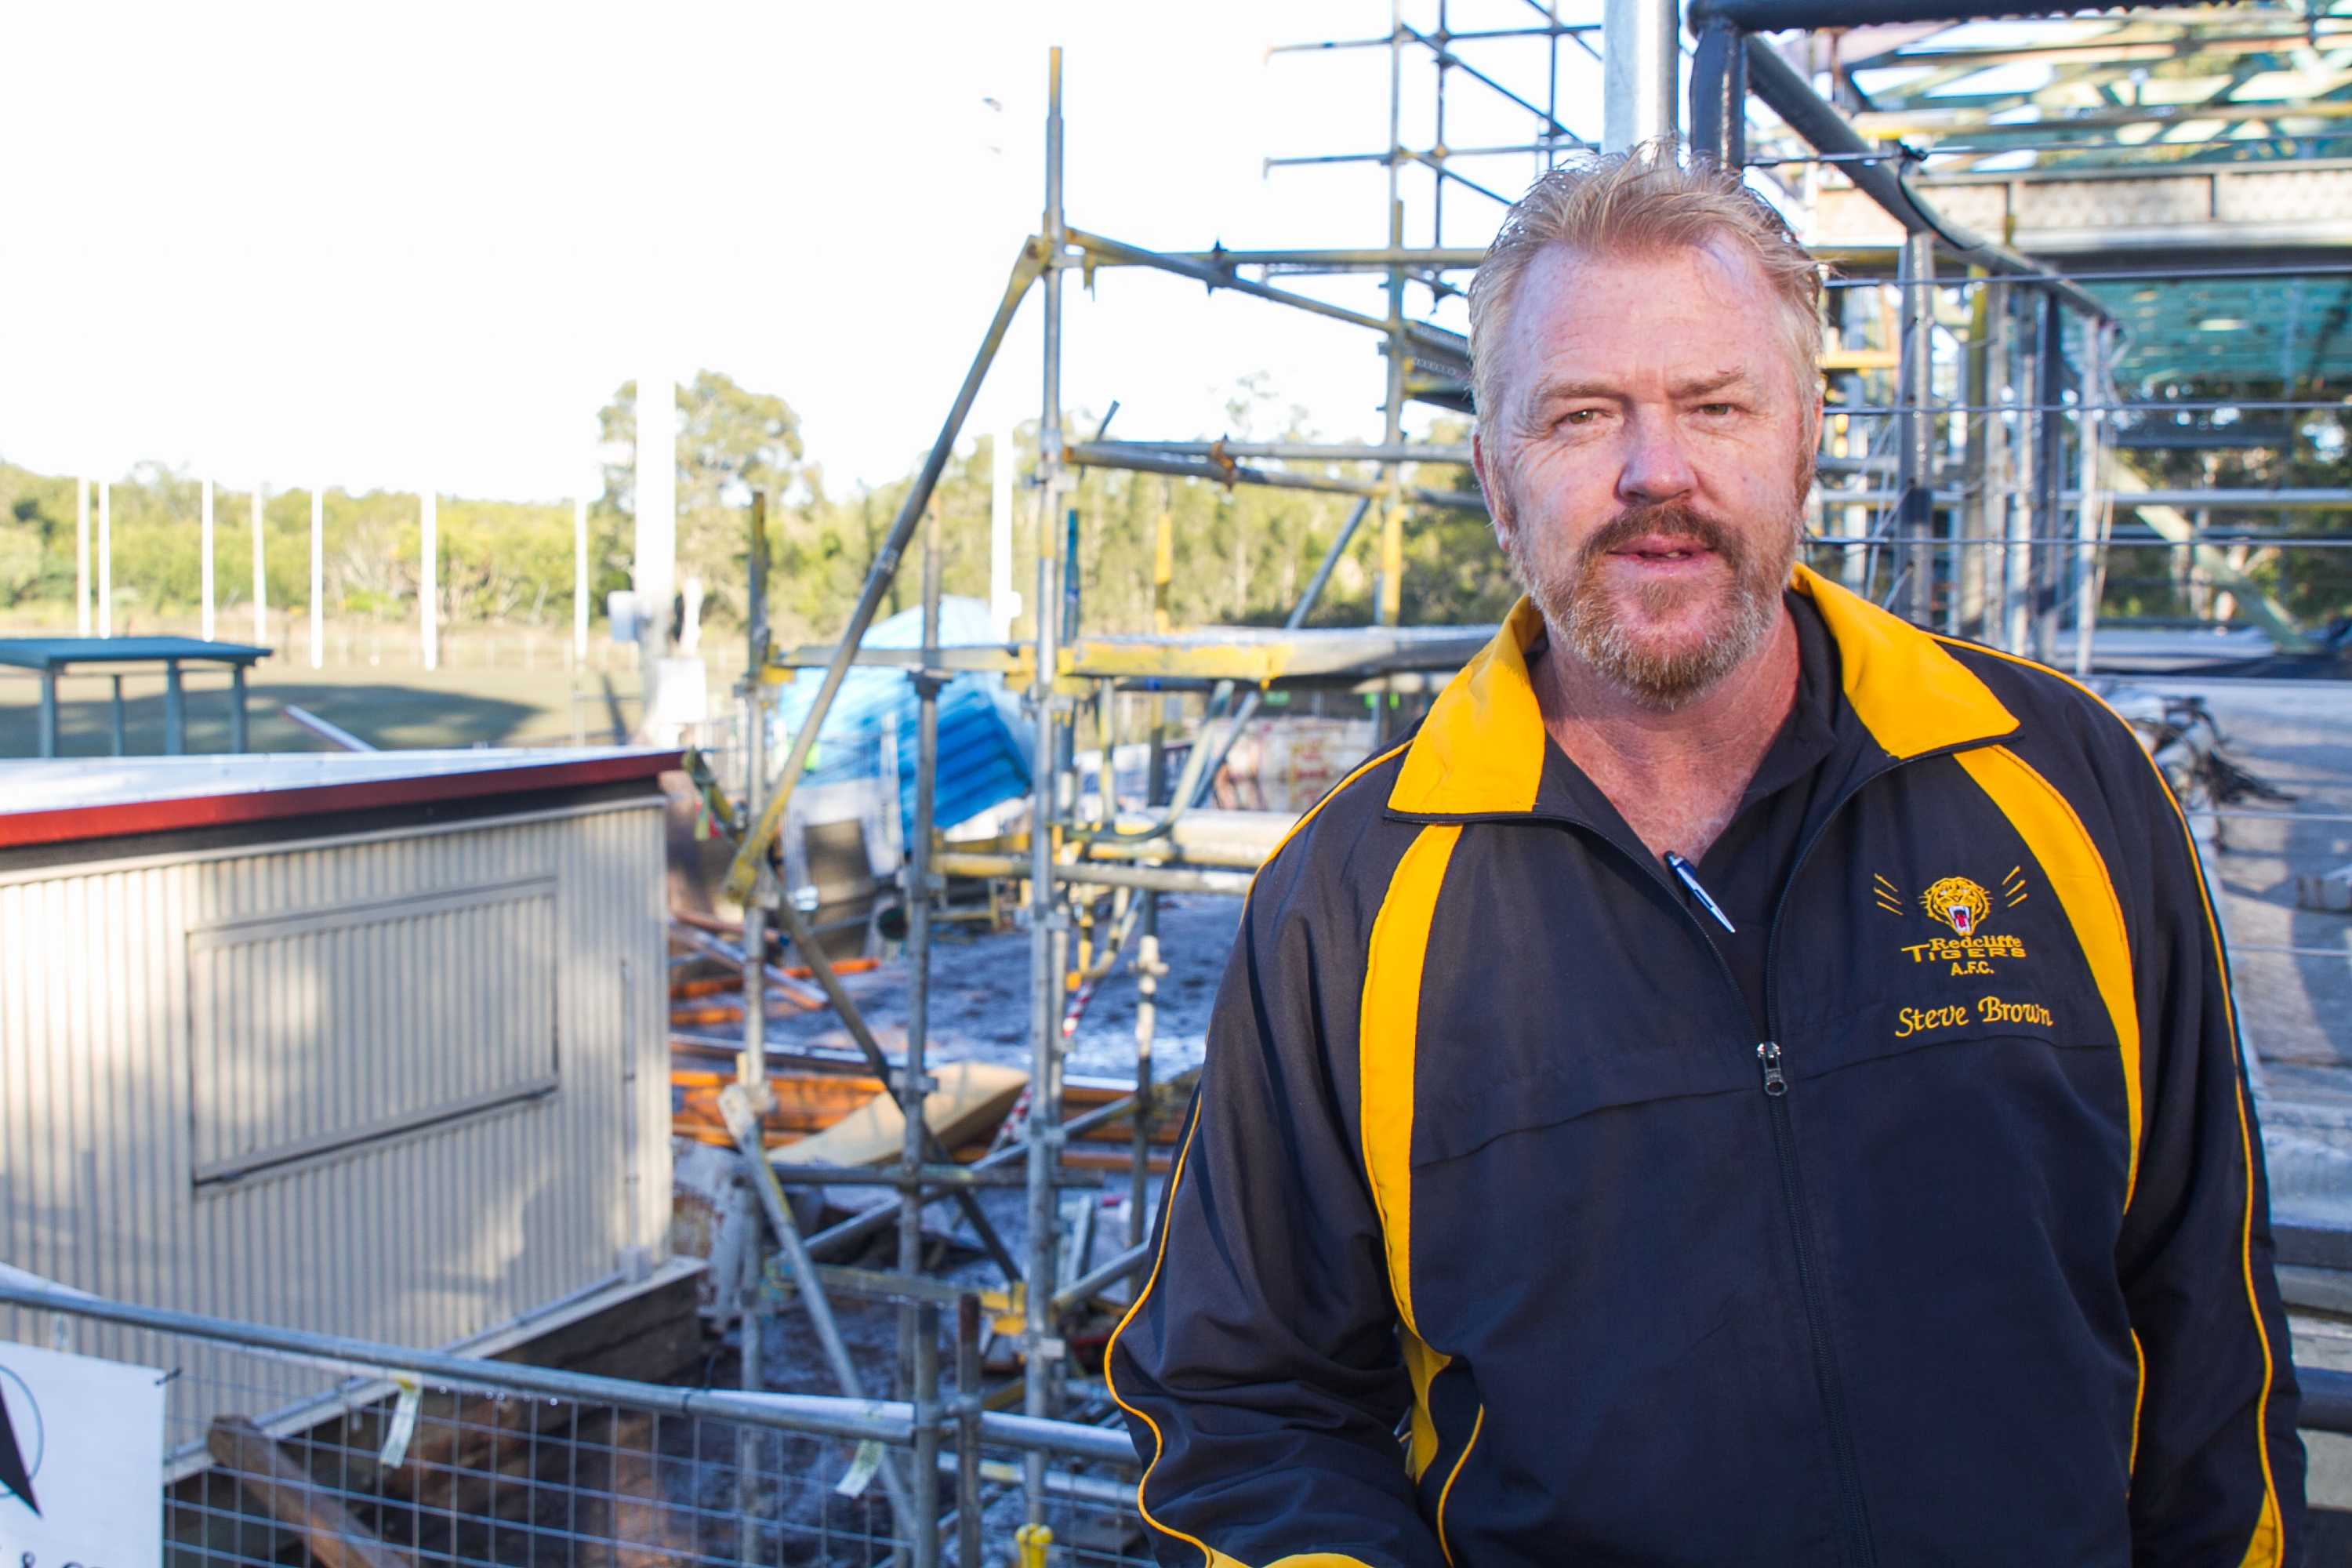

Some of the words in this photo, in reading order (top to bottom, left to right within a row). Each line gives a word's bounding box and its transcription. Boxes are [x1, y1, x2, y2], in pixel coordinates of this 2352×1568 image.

[1929, 935, 2022, 951] Redcliffe
[1951, 961, 1994, 976] A.F.C.
[1895, 1005, 1969, 1037] Steve
[1978, 996, 2053, 1026] Brown
